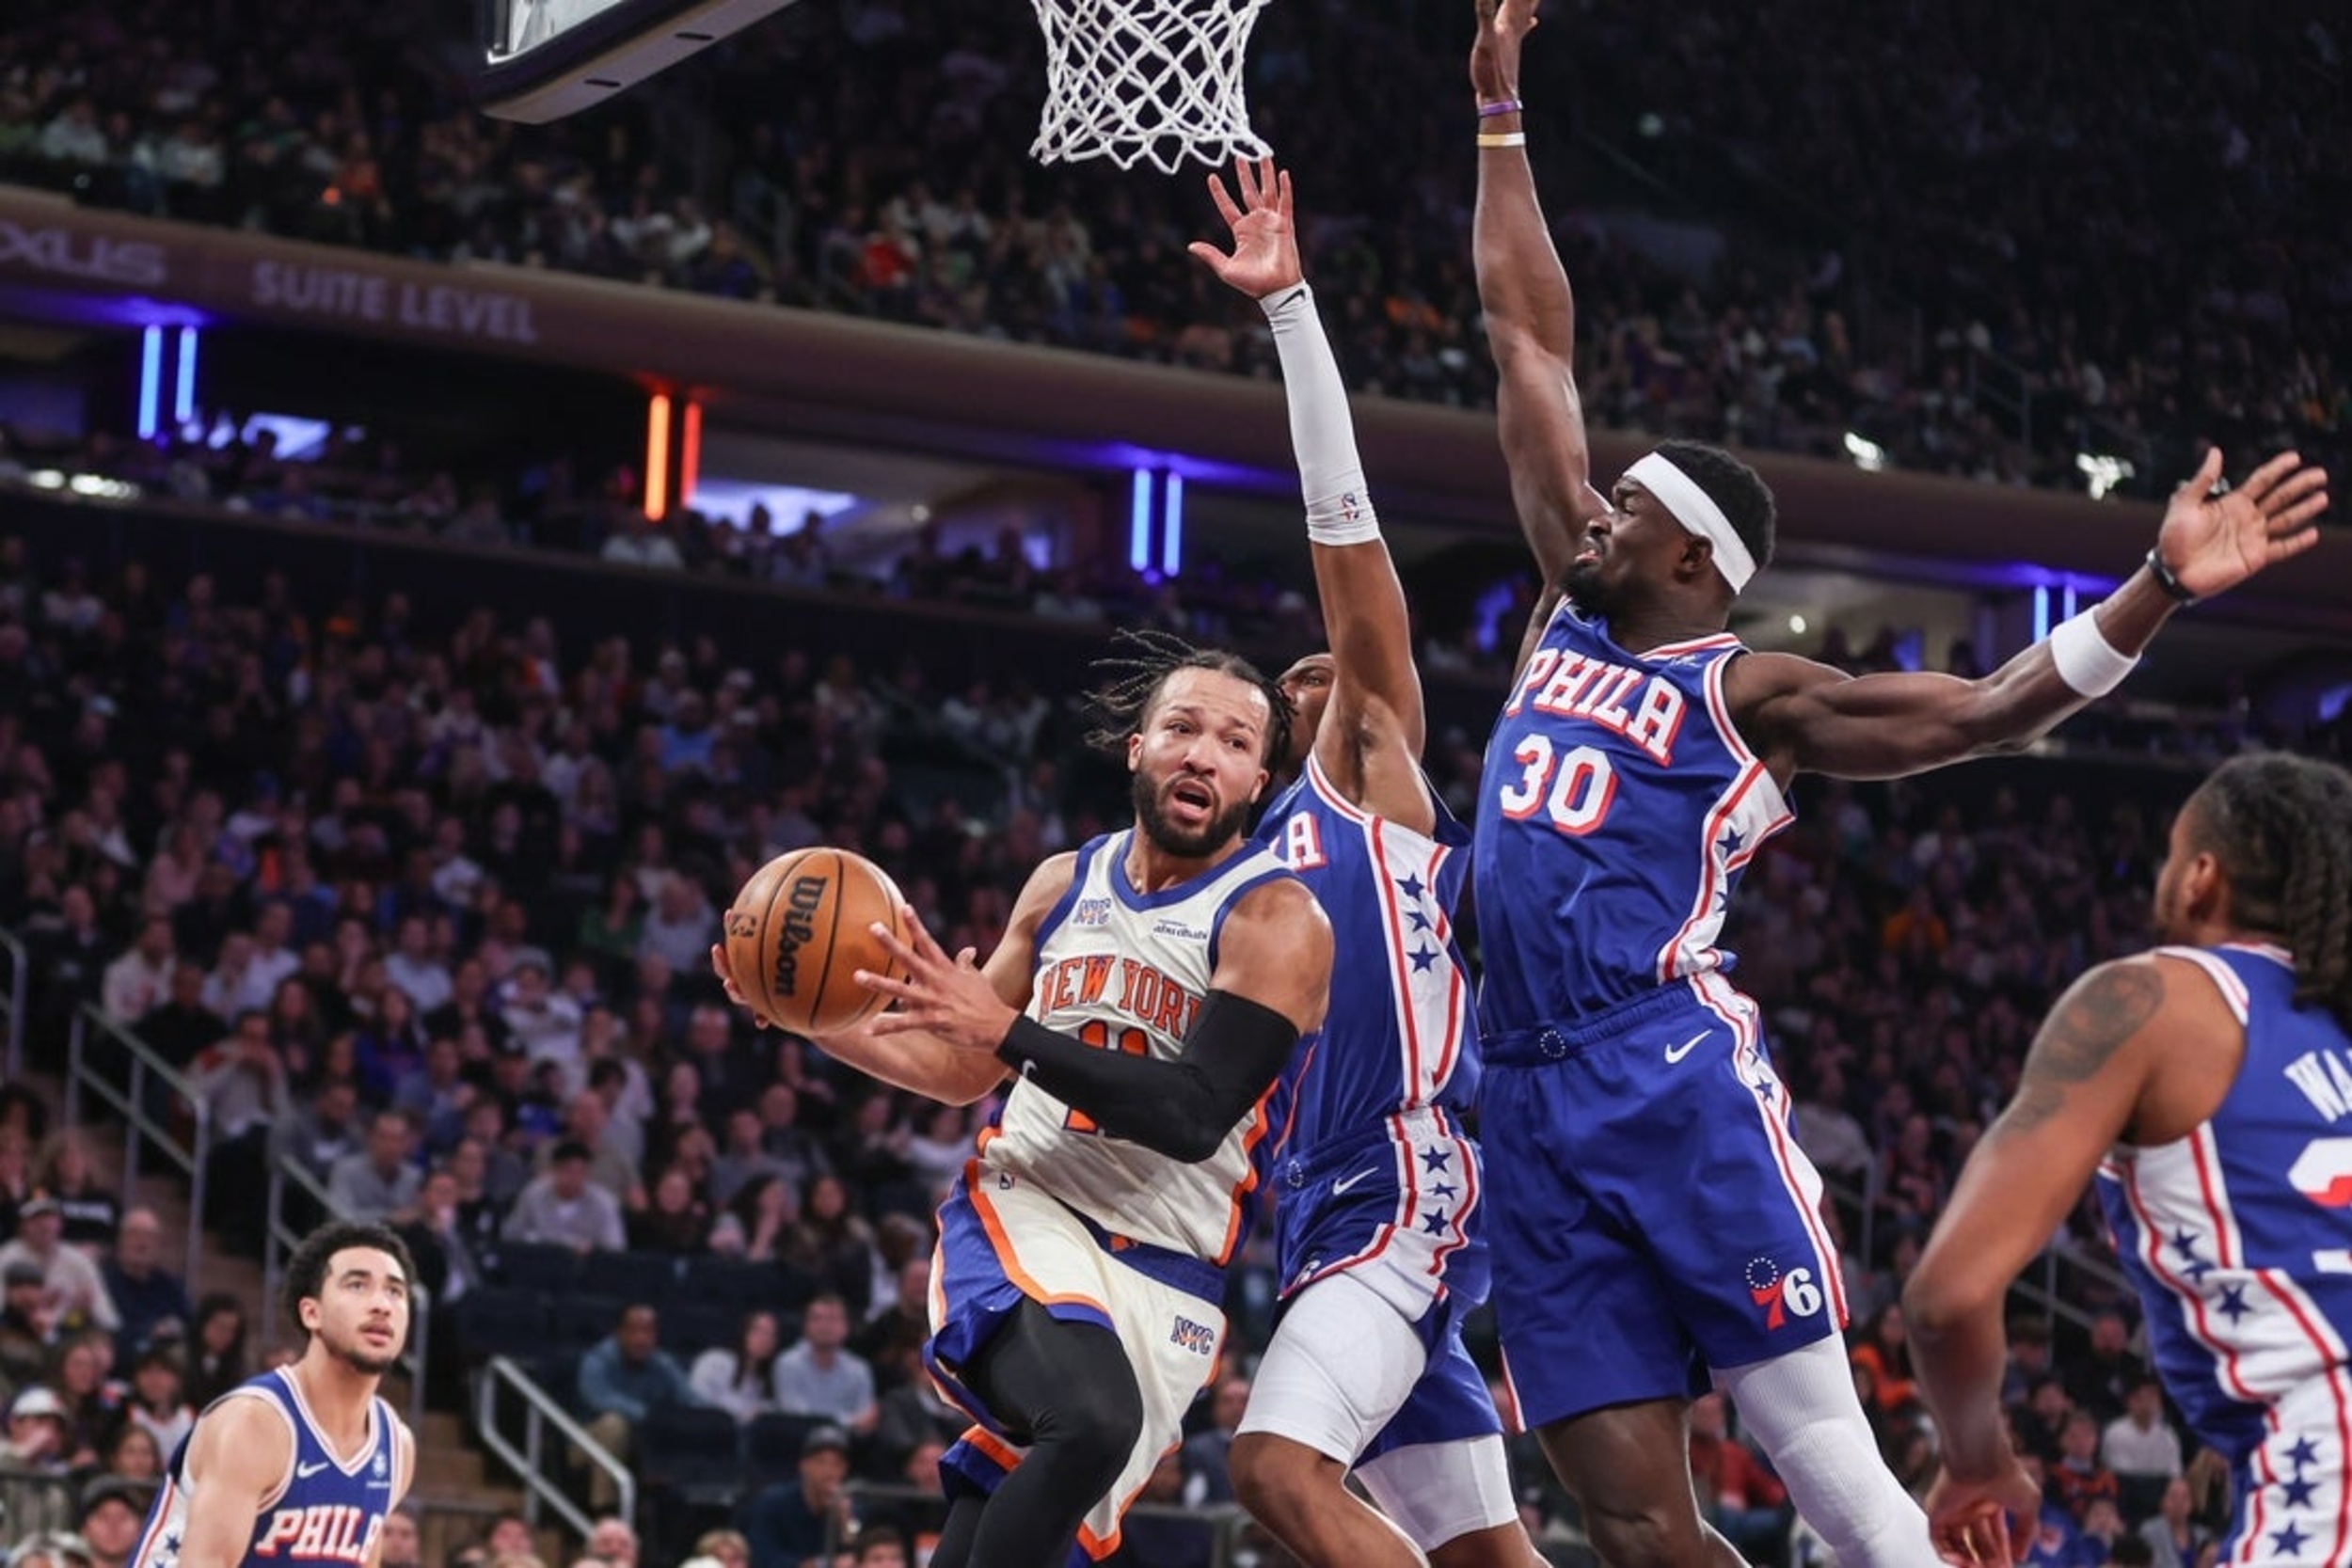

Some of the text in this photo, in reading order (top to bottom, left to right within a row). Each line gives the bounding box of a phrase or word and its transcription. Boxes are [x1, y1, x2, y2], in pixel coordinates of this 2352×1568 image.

[251, 261, 536, 342] SUITE LEVEL
[1506, 647, 1687, 768] PHILA
[1500, 733, 1619, 837] 30
[1268, 810, 1328, 874] A
[775, 876, 828, 998] Wilson
[1039, 956, 1116, 1024] NEW
[2283, 1049, 2352, 1123] WA
[1170, 1315, 1214, 1355] NYC
[1751, 1267, 1822, 1332] 76
